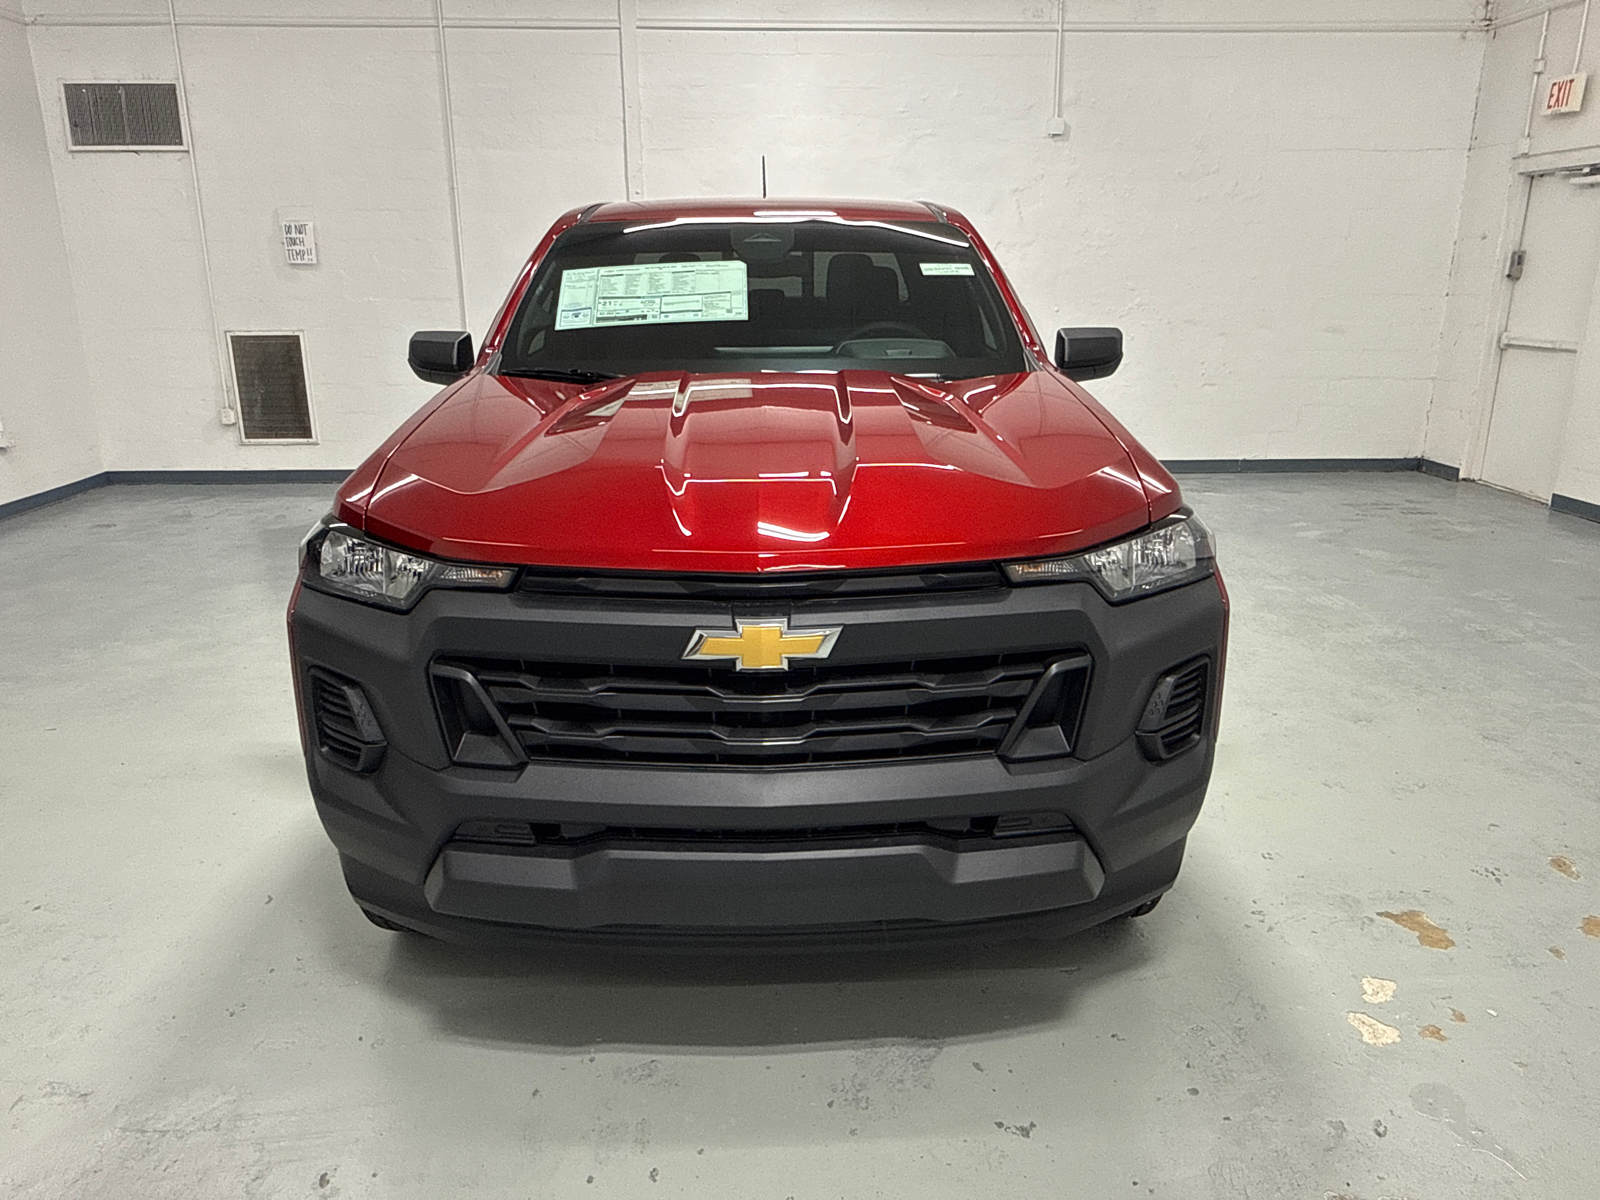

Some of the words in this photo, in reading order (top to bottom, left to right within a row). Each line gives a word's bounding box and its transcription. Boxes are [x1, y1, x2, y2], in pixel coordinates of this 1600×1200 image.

[1547, 78, 1575, 109] EXIT
[284, 224, 292, 235] DO
[294, 223, 308, 235] NOT
[285, 237, 305, 248] TOUCH
[287, 248, 313, 261] TEMP!!
